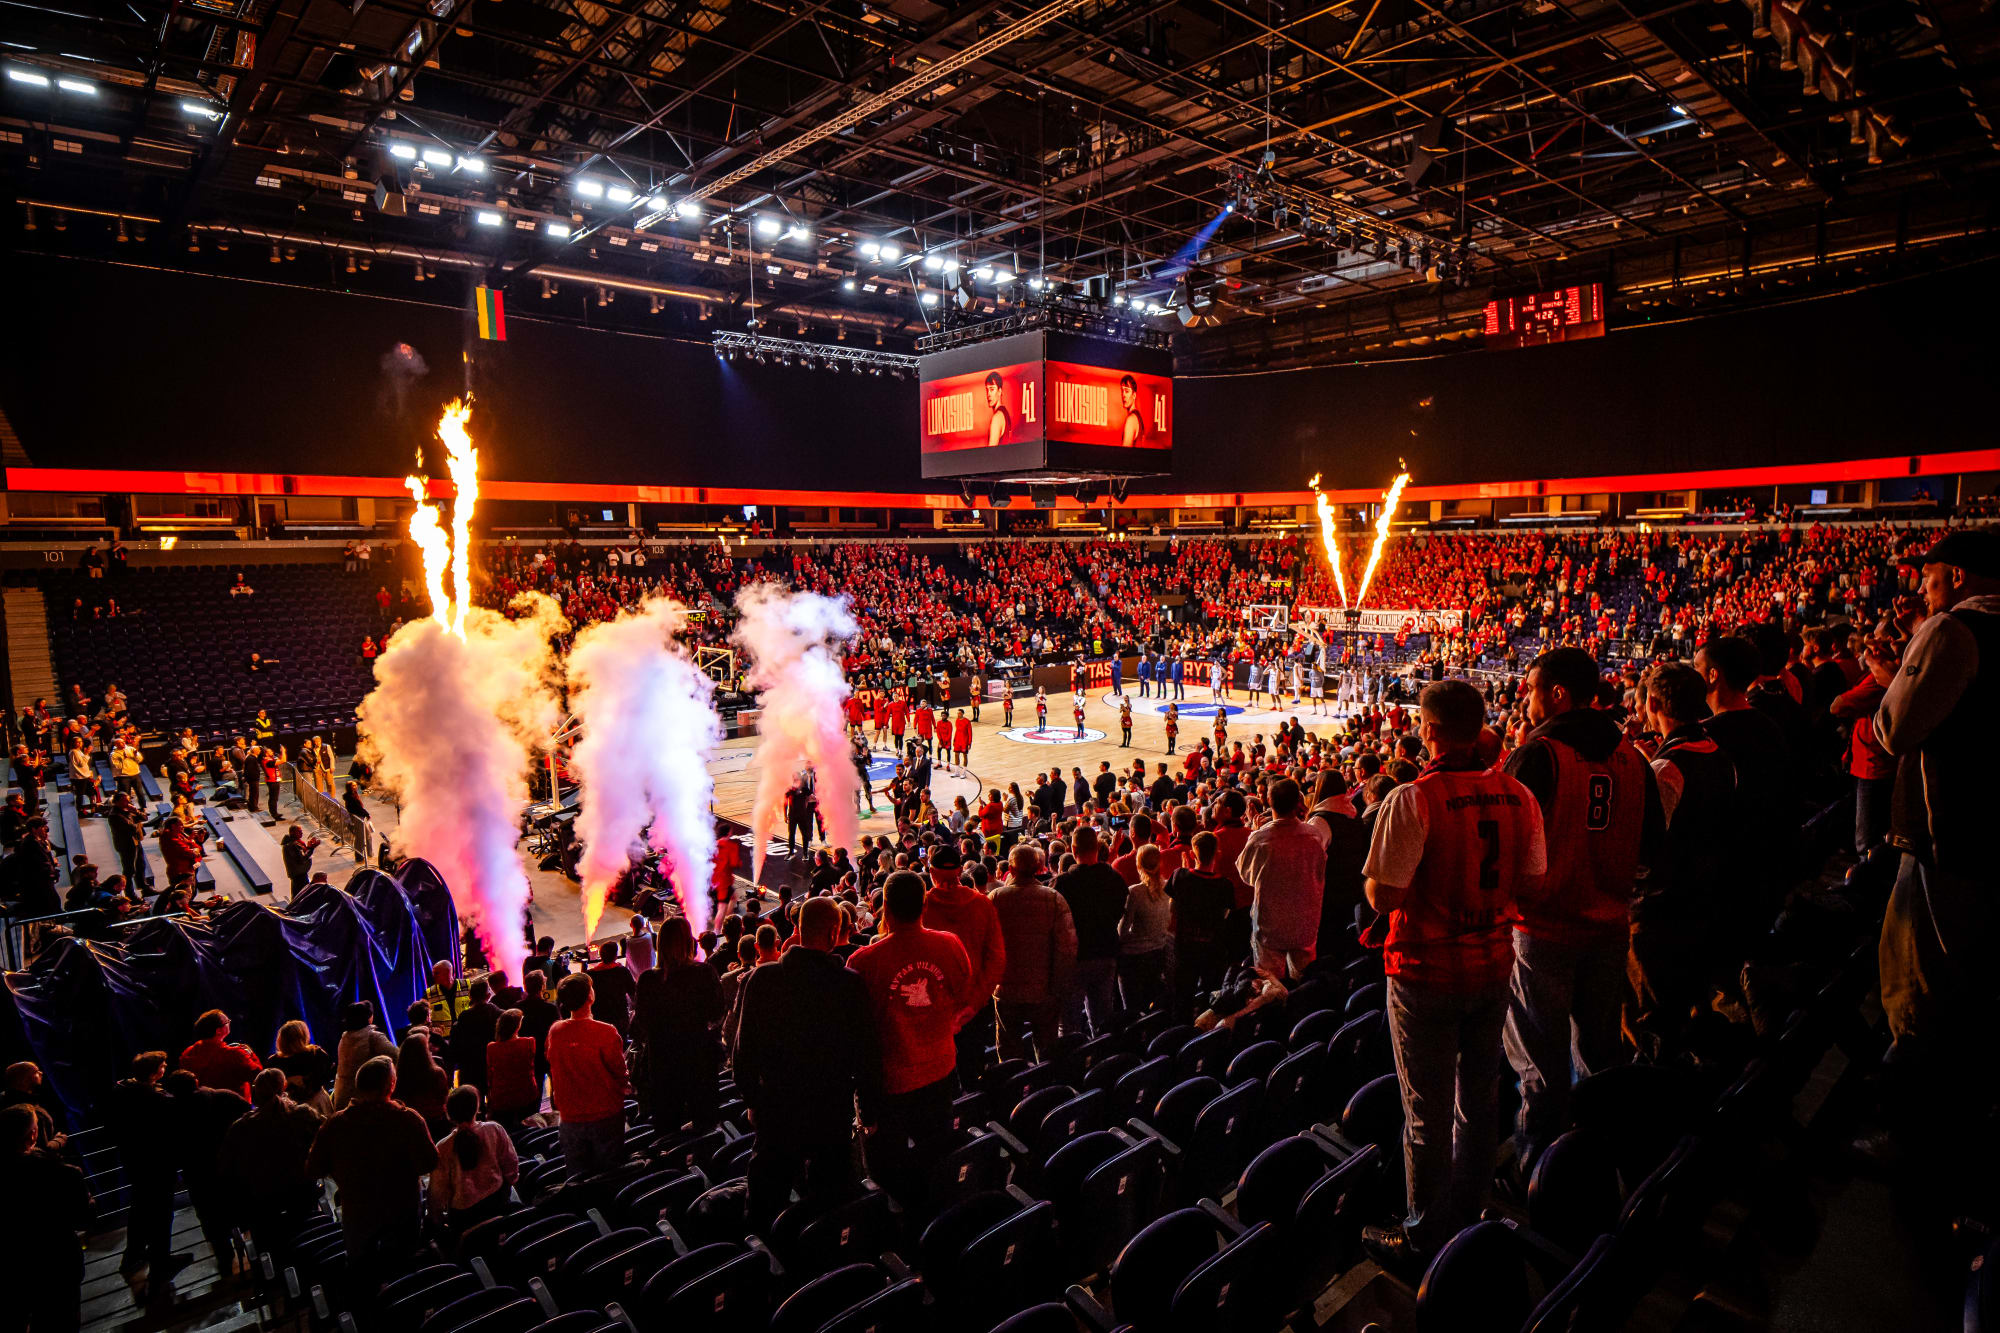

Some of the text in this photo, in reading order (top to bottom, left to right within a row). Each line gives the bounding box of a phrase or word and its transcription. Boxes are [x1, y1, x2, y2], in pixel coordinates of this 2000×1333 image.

[1021, 381, 1036, 423] 41
[1154, 393, 1167, 432] 41
[42, 551, 64, 562] 101
[687, 622, 703, 635] 24
[1585, 773, 1613, 830] 8
[1477, 820, 1499, 889] 2
[889, 963, 913, 990] RYTAS
